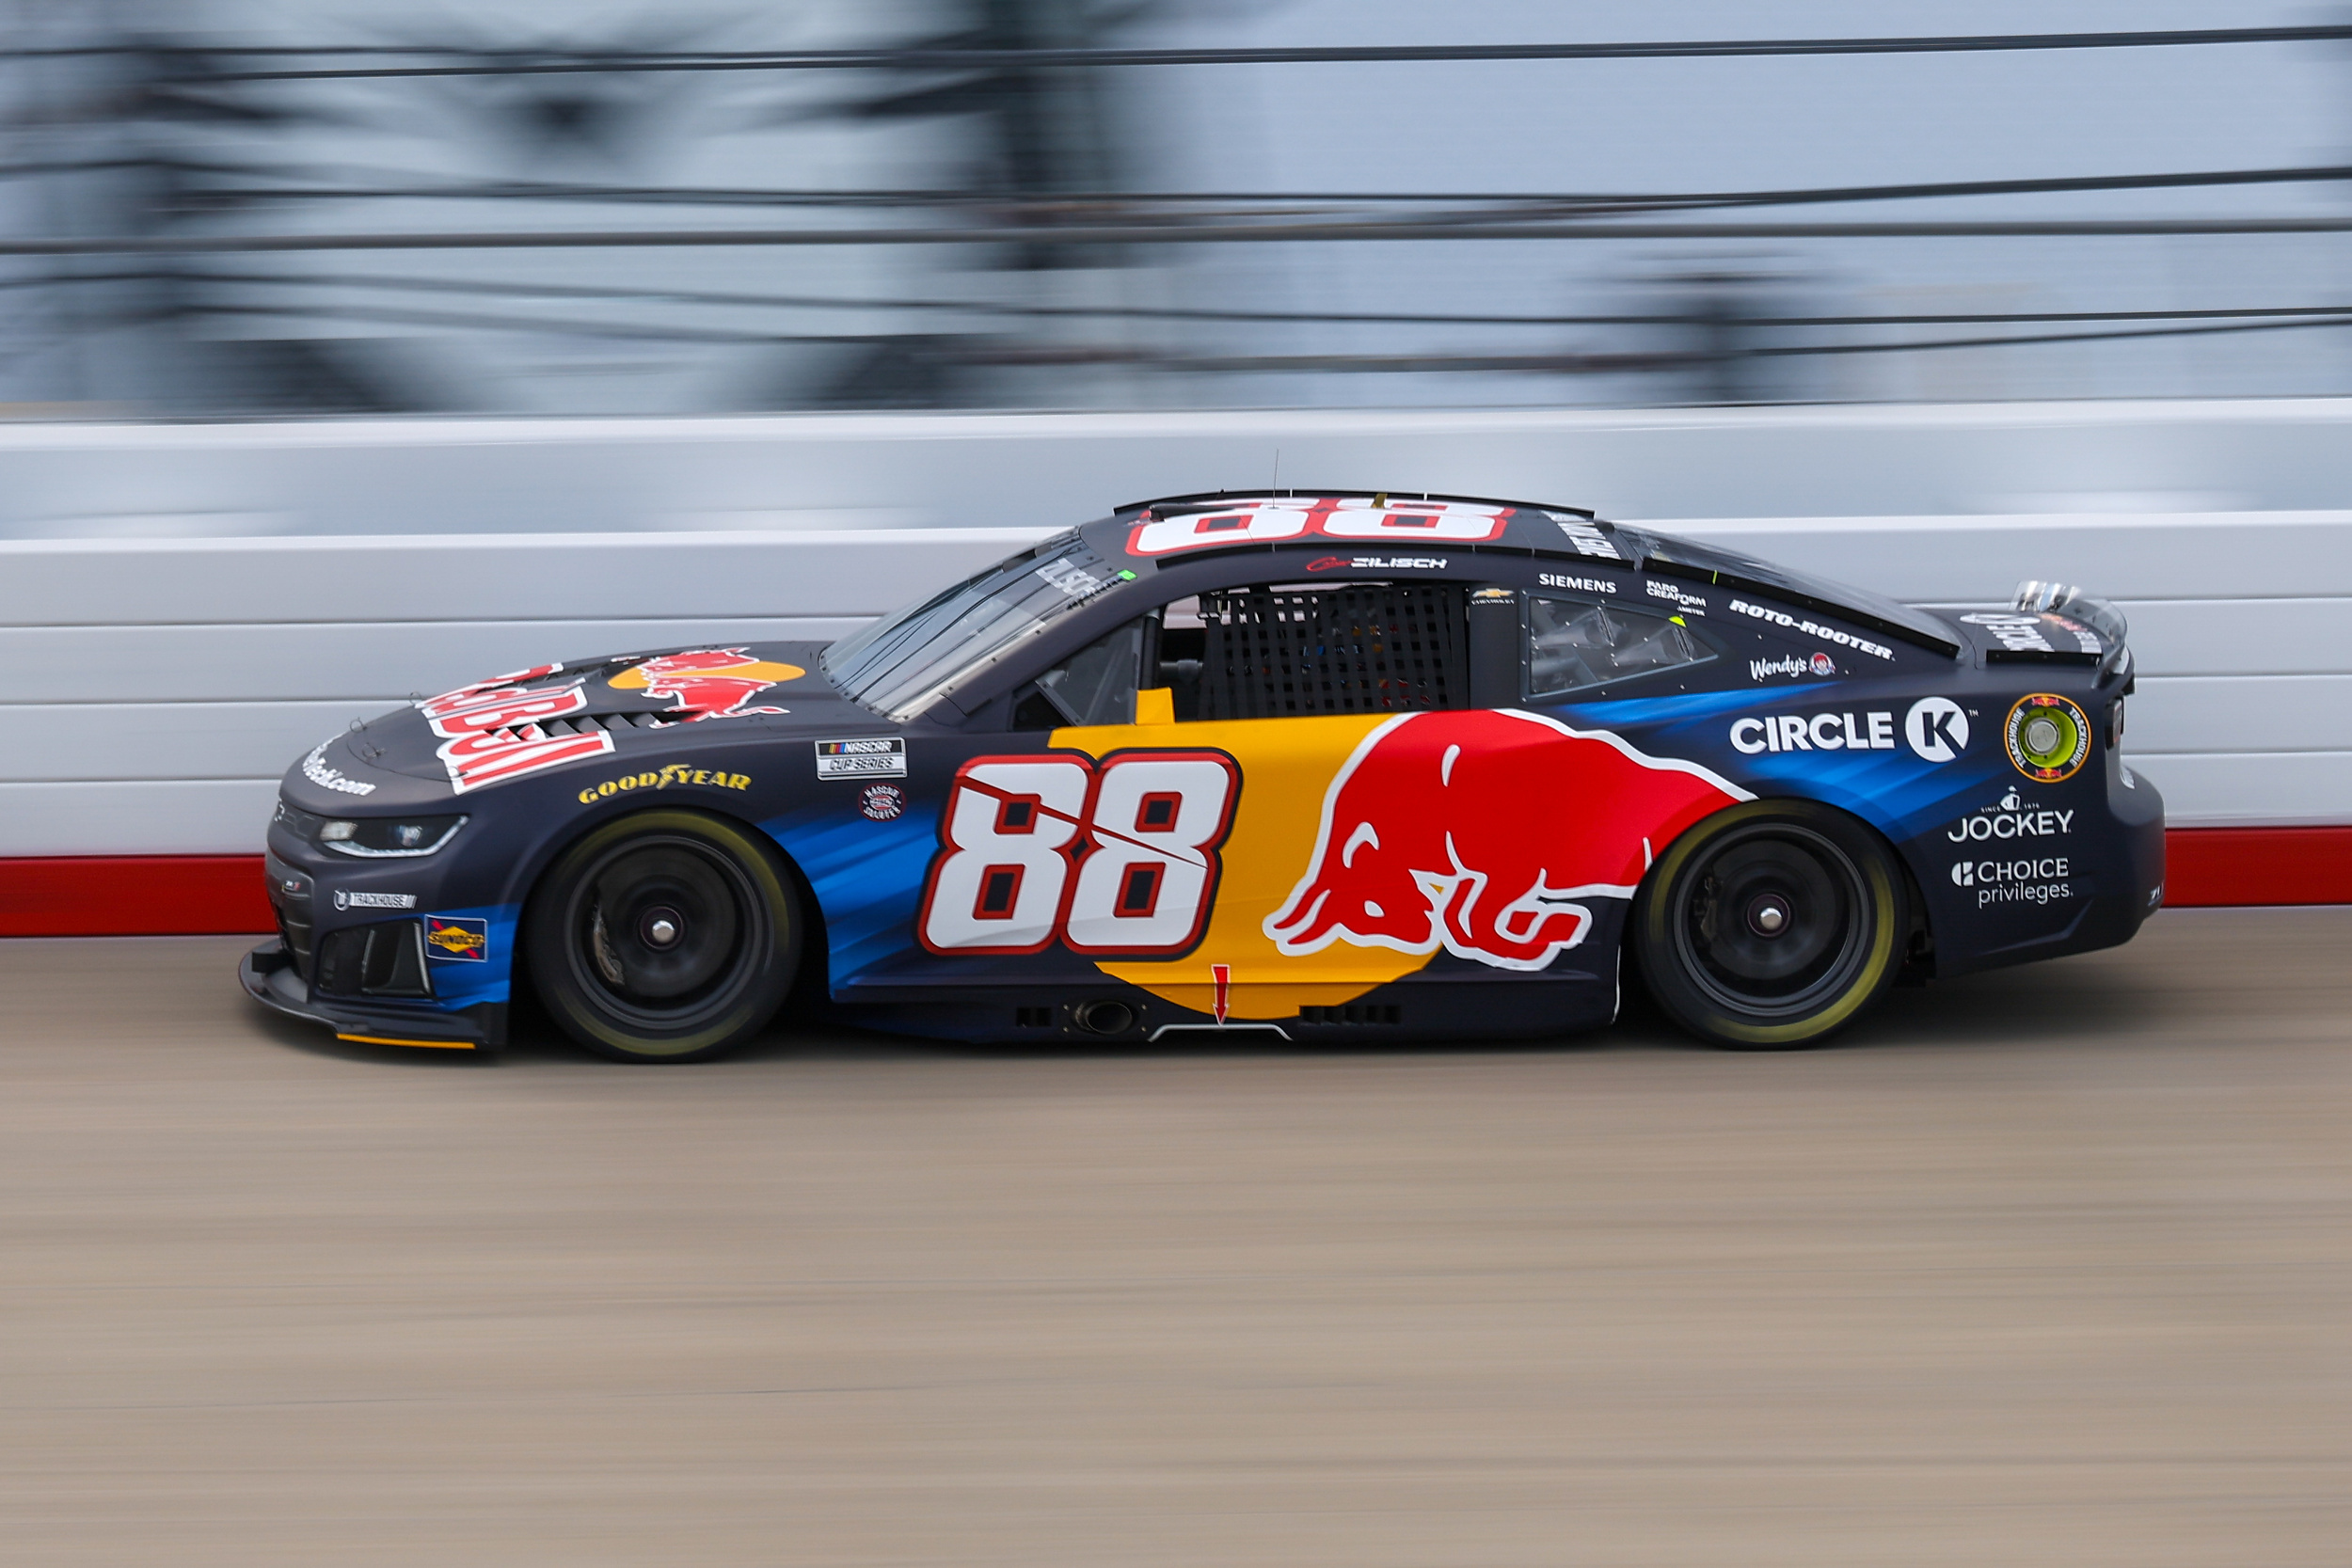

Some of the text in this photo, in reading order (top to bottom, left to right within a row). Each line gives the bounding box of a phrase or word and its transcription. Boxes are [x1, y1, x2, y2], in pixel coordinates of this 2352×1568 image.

[1351, 557, 1448, 569] ZILISCH
[1538, 572, 1617, 594] SIEMENS
[1646, 587, 1707, 608] CREAFORM
[1729, 599, 1893, 660] ROTO-ROOTER
[1749, 654, 1807, 681] Wendy's
[1729, 712, 1896, 754] CIRCLE
[1915, 704, 1969, 760] K
[845, 741, 893, 754] NASCAR
[830, 757, 894, 770] CUP SERIES
[579, 764, 751, 805] GOODYEAR
[1947, 809, 2074, 843] JOCKEY
[918, 752, 1240, 957] 88
[1978, 857, 2069, 883] CHOICE
